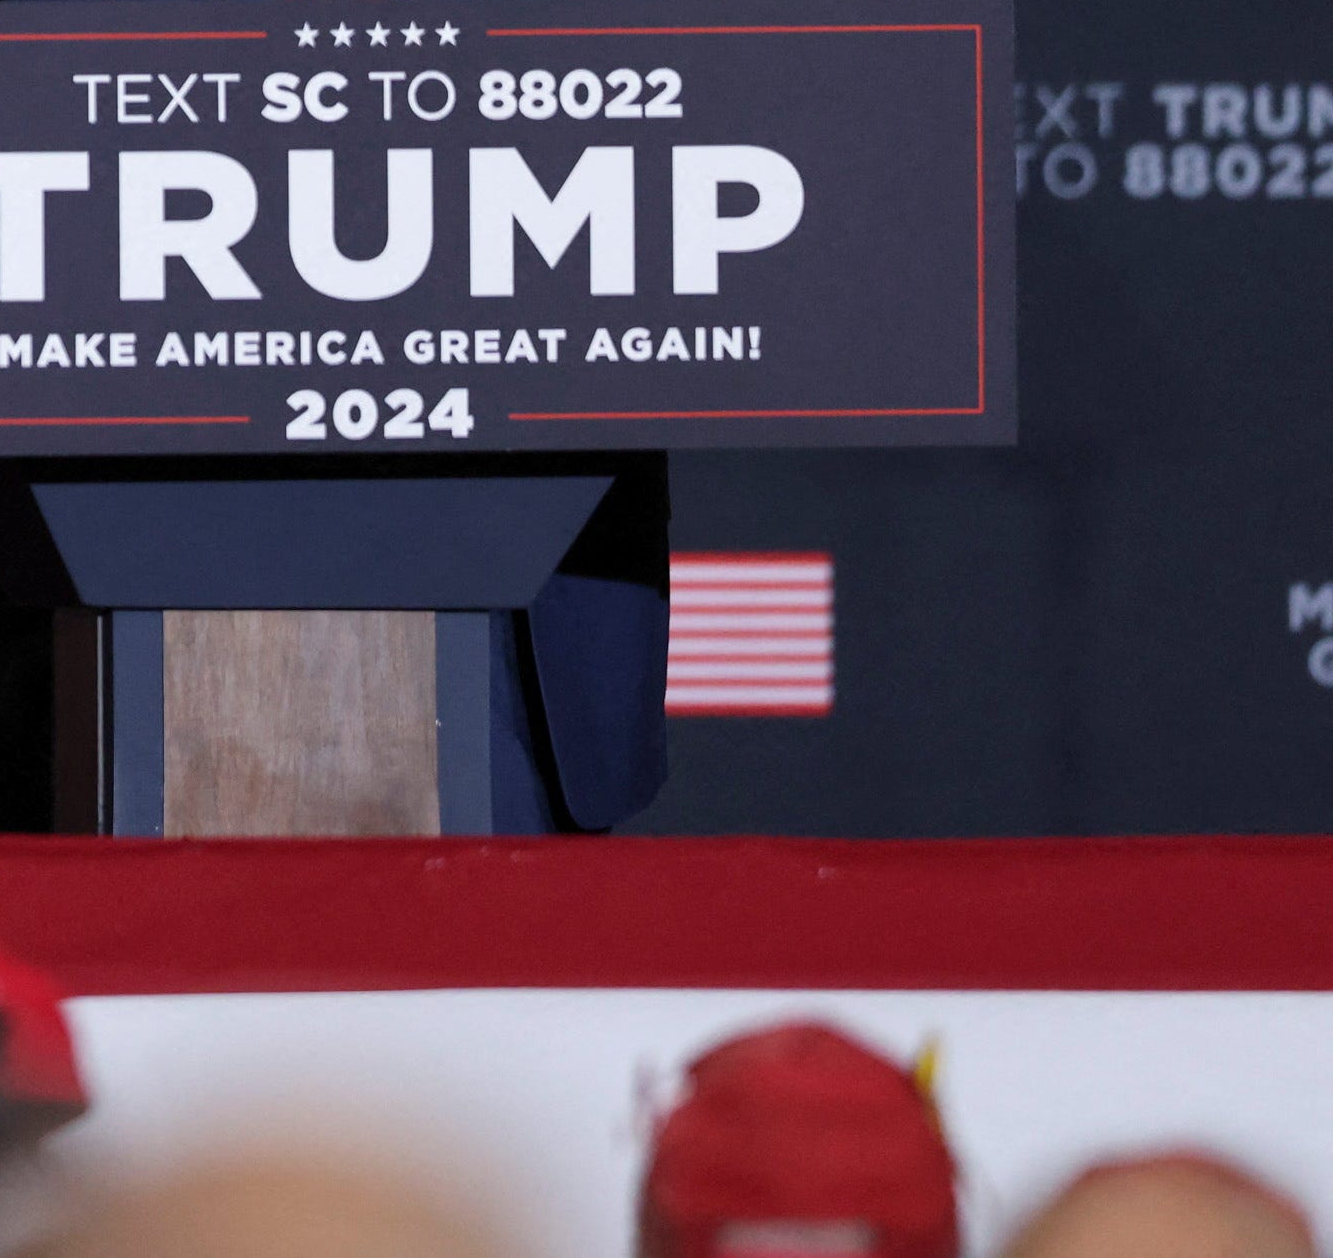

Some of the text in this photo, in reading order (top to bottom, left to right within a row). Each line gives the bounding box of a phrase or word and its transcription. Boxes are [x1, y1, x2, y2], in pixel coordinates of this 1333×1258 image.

[74, 67, 684, 124] TEXT SC TO 88022
[156, 330, 385, 367] AMERICA
[403, 328, 567, 366] GREAT
[585, 325, 763, 363] AGAIN!
[285, 388, 475, 441] 2024
